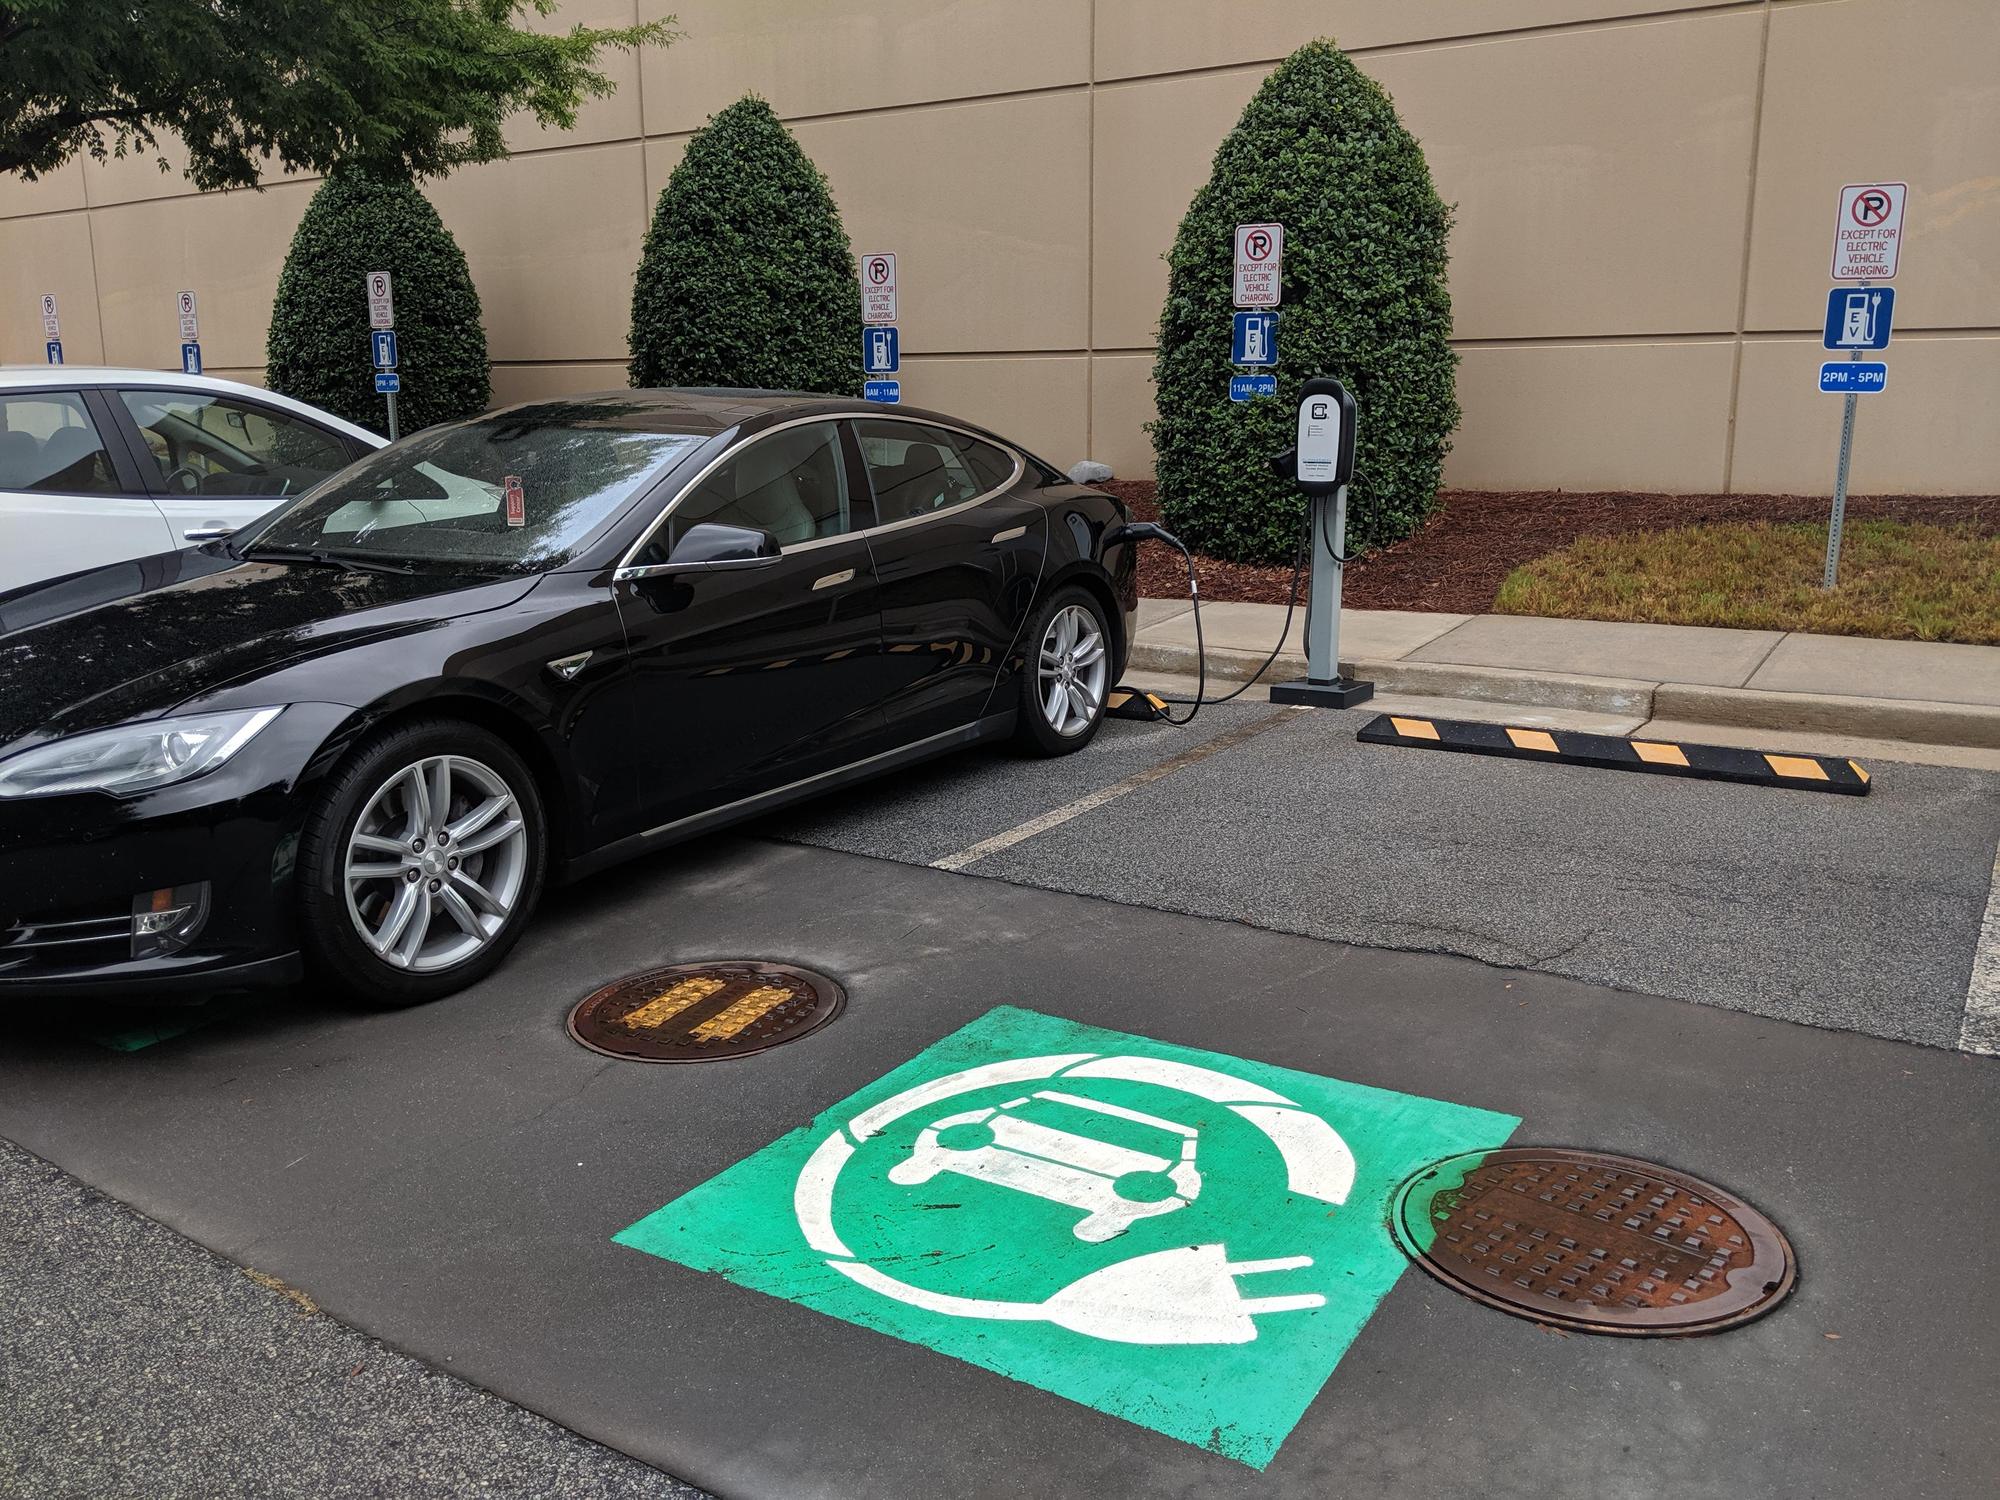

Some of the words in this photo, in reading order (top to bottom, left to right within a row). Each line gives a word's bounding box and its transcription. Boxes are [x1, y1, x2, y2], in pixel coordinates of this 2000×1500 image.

[1863, 197, 1884, 220] P
[1841, 230, 1876, 240] EXCEPT
[1878, 229, 1896, 239] FOR
[1253, 236, 1267, 256] P
[1846, 241, 1888, 251] ELECTRIC
[1848, 253, 1885, 263] VEHICLE
[874, 262, 885, 280] P
[1239, 264, 1262, 272] EXCEPT
[1264, 263, 1277, 271] FOR
[1841, 265, 1888, 275] CHARGING
[1243, 273, 1272, 282] ELECTRIC
[865, 286, 883, 294] EXCEPT
[1245, 283, 1270, 292] VEHICLE
[868, 294, 890, 302] ELECTRIC
[1240, 293, 1273, 302] CHARGING
[870, 303, 889, 311] VEHICLE
[867, 312, 893, 320] CHARGING
[1823, 372, 1848, 382] 2PM
[1858, 372, 1884, 382] 5PM
[883, 388, 898, 396] 11AM
[1233, 384, 1252, 393] 11AM
[1258, 384, 1274, 393] 2PM
